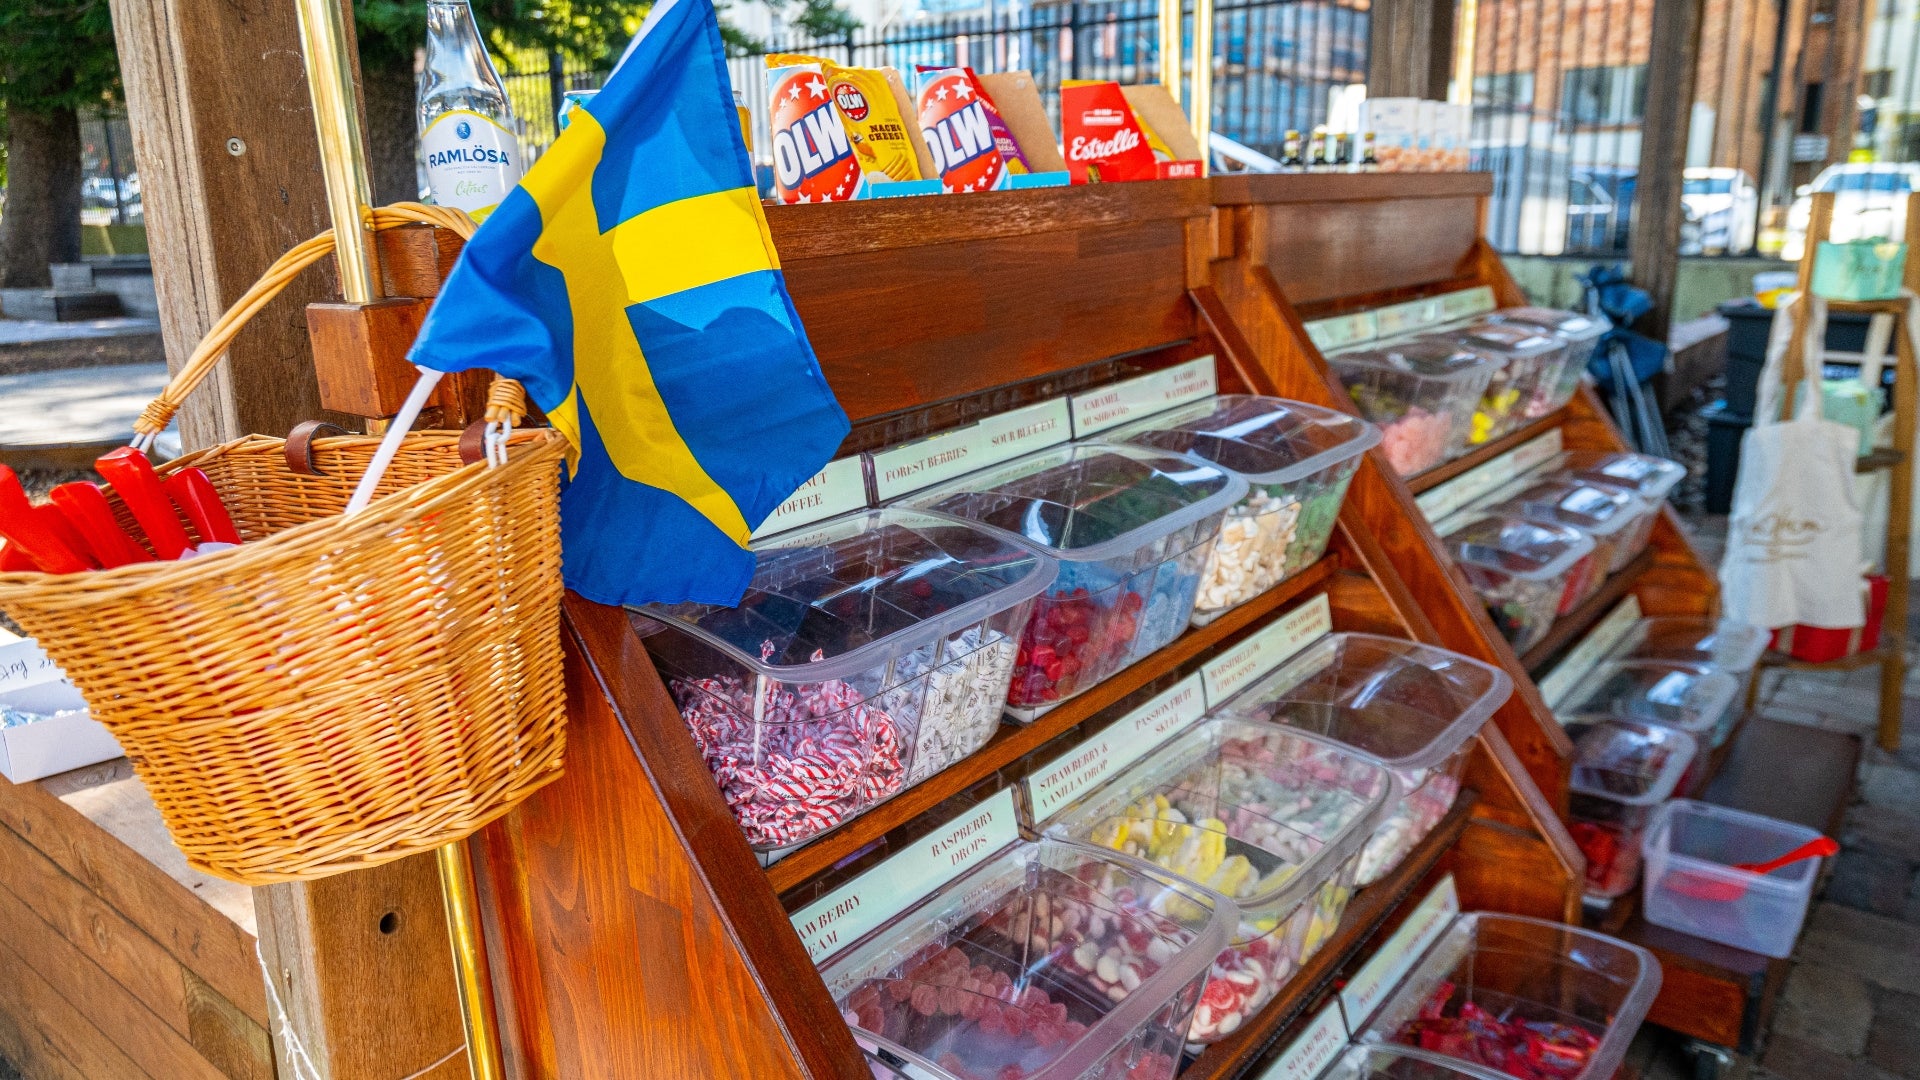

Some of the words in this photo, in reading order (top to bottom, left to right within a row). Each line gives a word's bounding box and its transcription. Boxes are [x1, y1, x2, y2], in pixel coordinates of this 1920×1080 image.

[836, 92, 865, 111] OLW
[429, 145, 510, 168] RAMLÖSA
[773, 100, 851, 188] OLW
[1070, 128, 1140, 161] Estrella
[455, 180, 489, 196] Citrus
[1084, 392, 1120, 411] CARAMEL
[991, 430, 1015, 448] SOUR
[885, 459, 926, 482] FOREST
[927, 445, 968, 468] BERRIES
[776, 493, 823, 517] TOFFEE
[1135, 704, 1170, 731] PASSION
[1039, 748, 1099, 793] STRAWBERRY
[1042, 777, 1084, 809] VANILLA
[1083, 759, 1109, 783] DROP
[931, 811, 993, 858] RASPBERRY
[951, 837, 988, 867] DROPS
